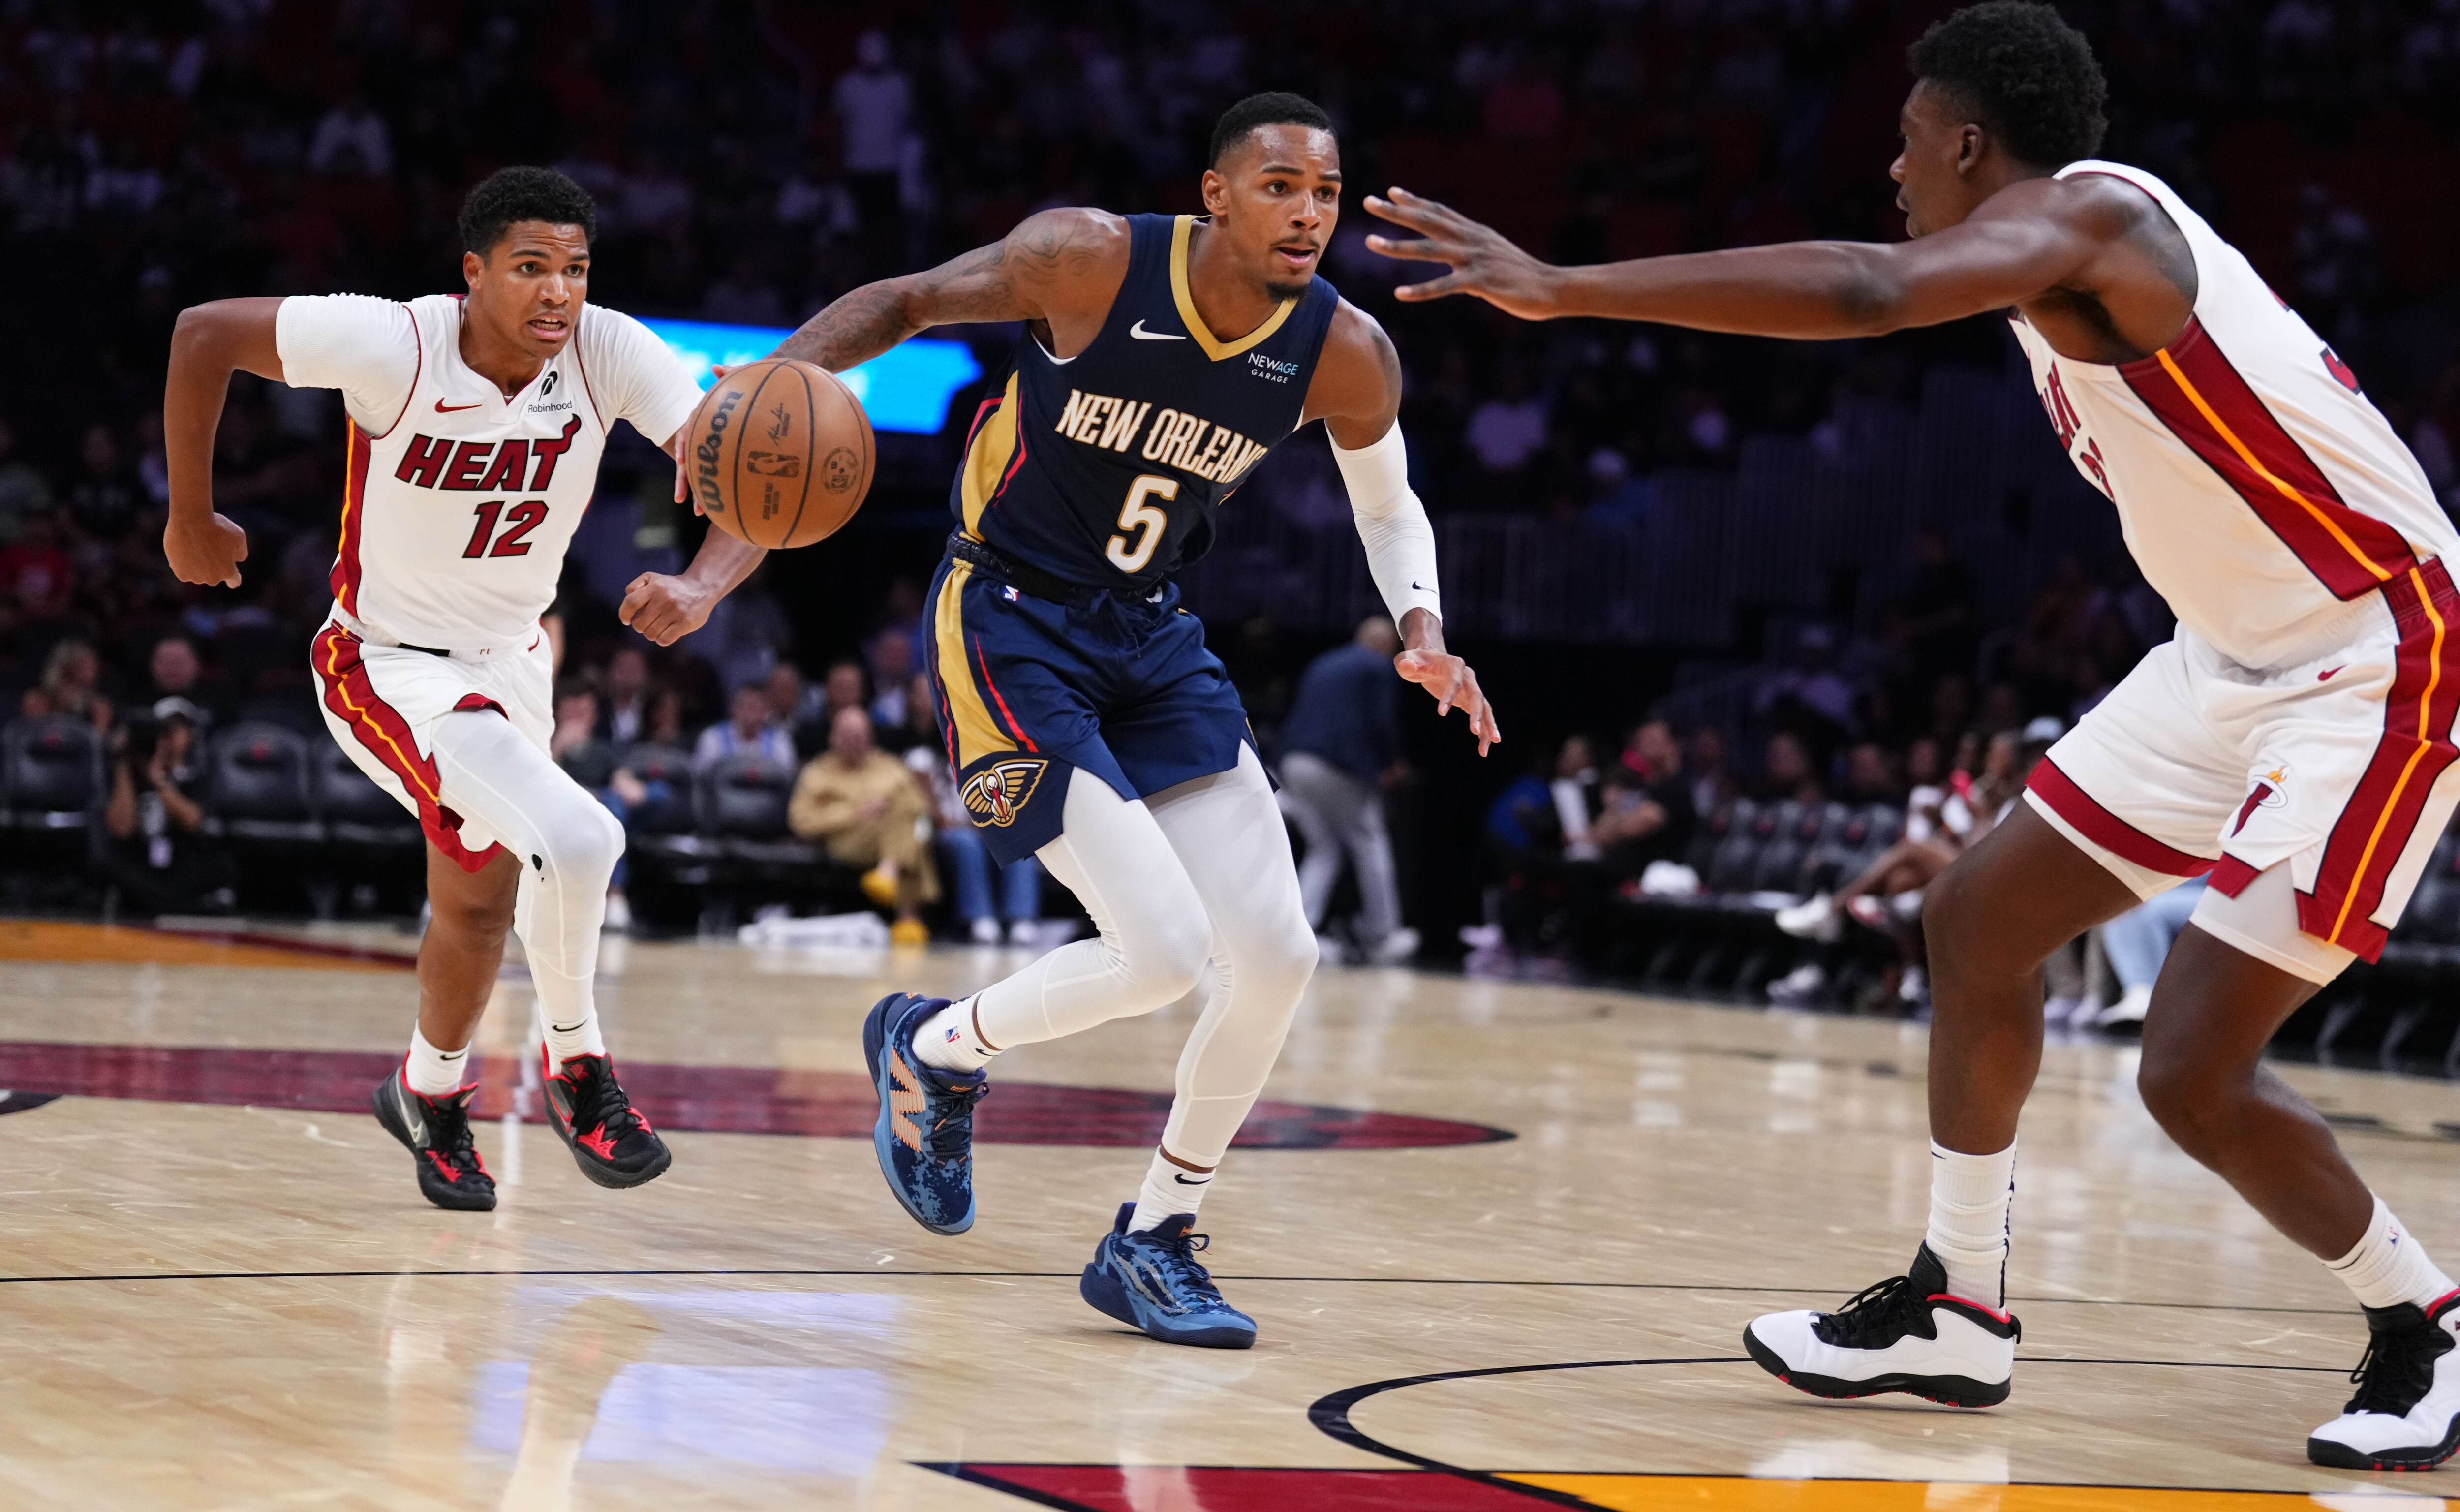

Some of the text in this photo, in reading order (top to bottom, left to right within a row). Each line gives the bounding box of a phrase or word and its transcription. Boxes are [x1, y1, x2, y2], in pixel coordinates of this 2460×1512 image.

[528, 400, 572, 413] Robinhood
[1251, 369, 1288, 384] GARAGE
[394, 413, 582, 492] HEAT
[696, 391, 745, 513] Wilson
[1054, 388, 1152, 453] NEW
[461, 500, 549, 558] 12
[1105, 474, 1180, 574] 5
